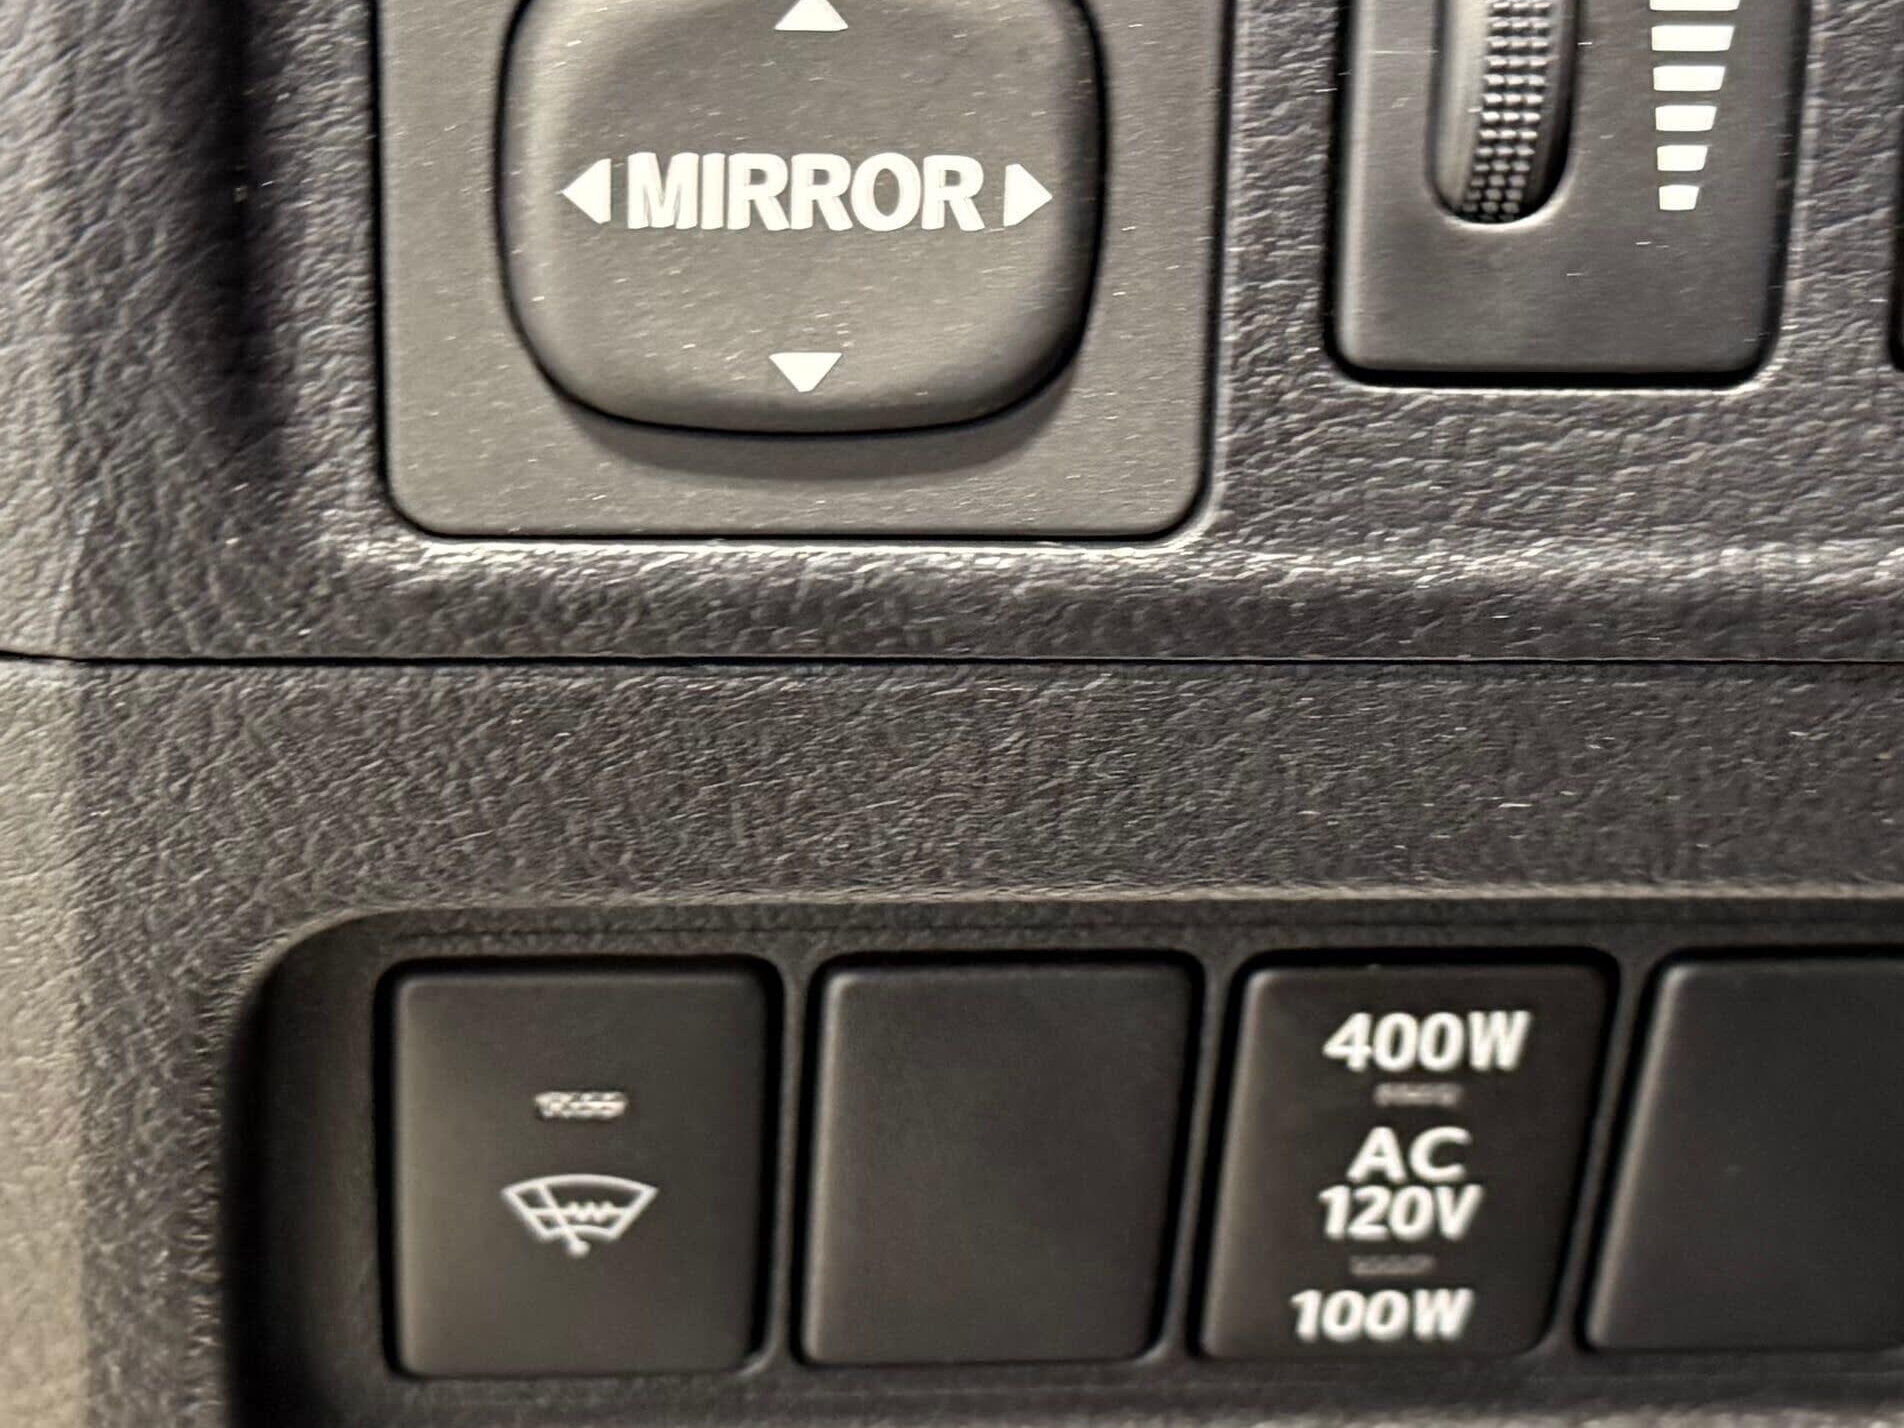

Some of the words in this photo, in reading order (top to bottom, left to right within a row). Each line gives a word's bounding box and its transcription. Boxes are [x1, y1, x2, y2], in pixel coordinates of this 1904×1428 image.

[626, 151, 986, 233] MIRROR
[1322, 1009, 1532, 1072] 400W
[1346, 1125, 1473, 1183] AC
[1317, 1184, 1483, 1241] 120V
[1289, 1287, 1475, 1342] 100W
